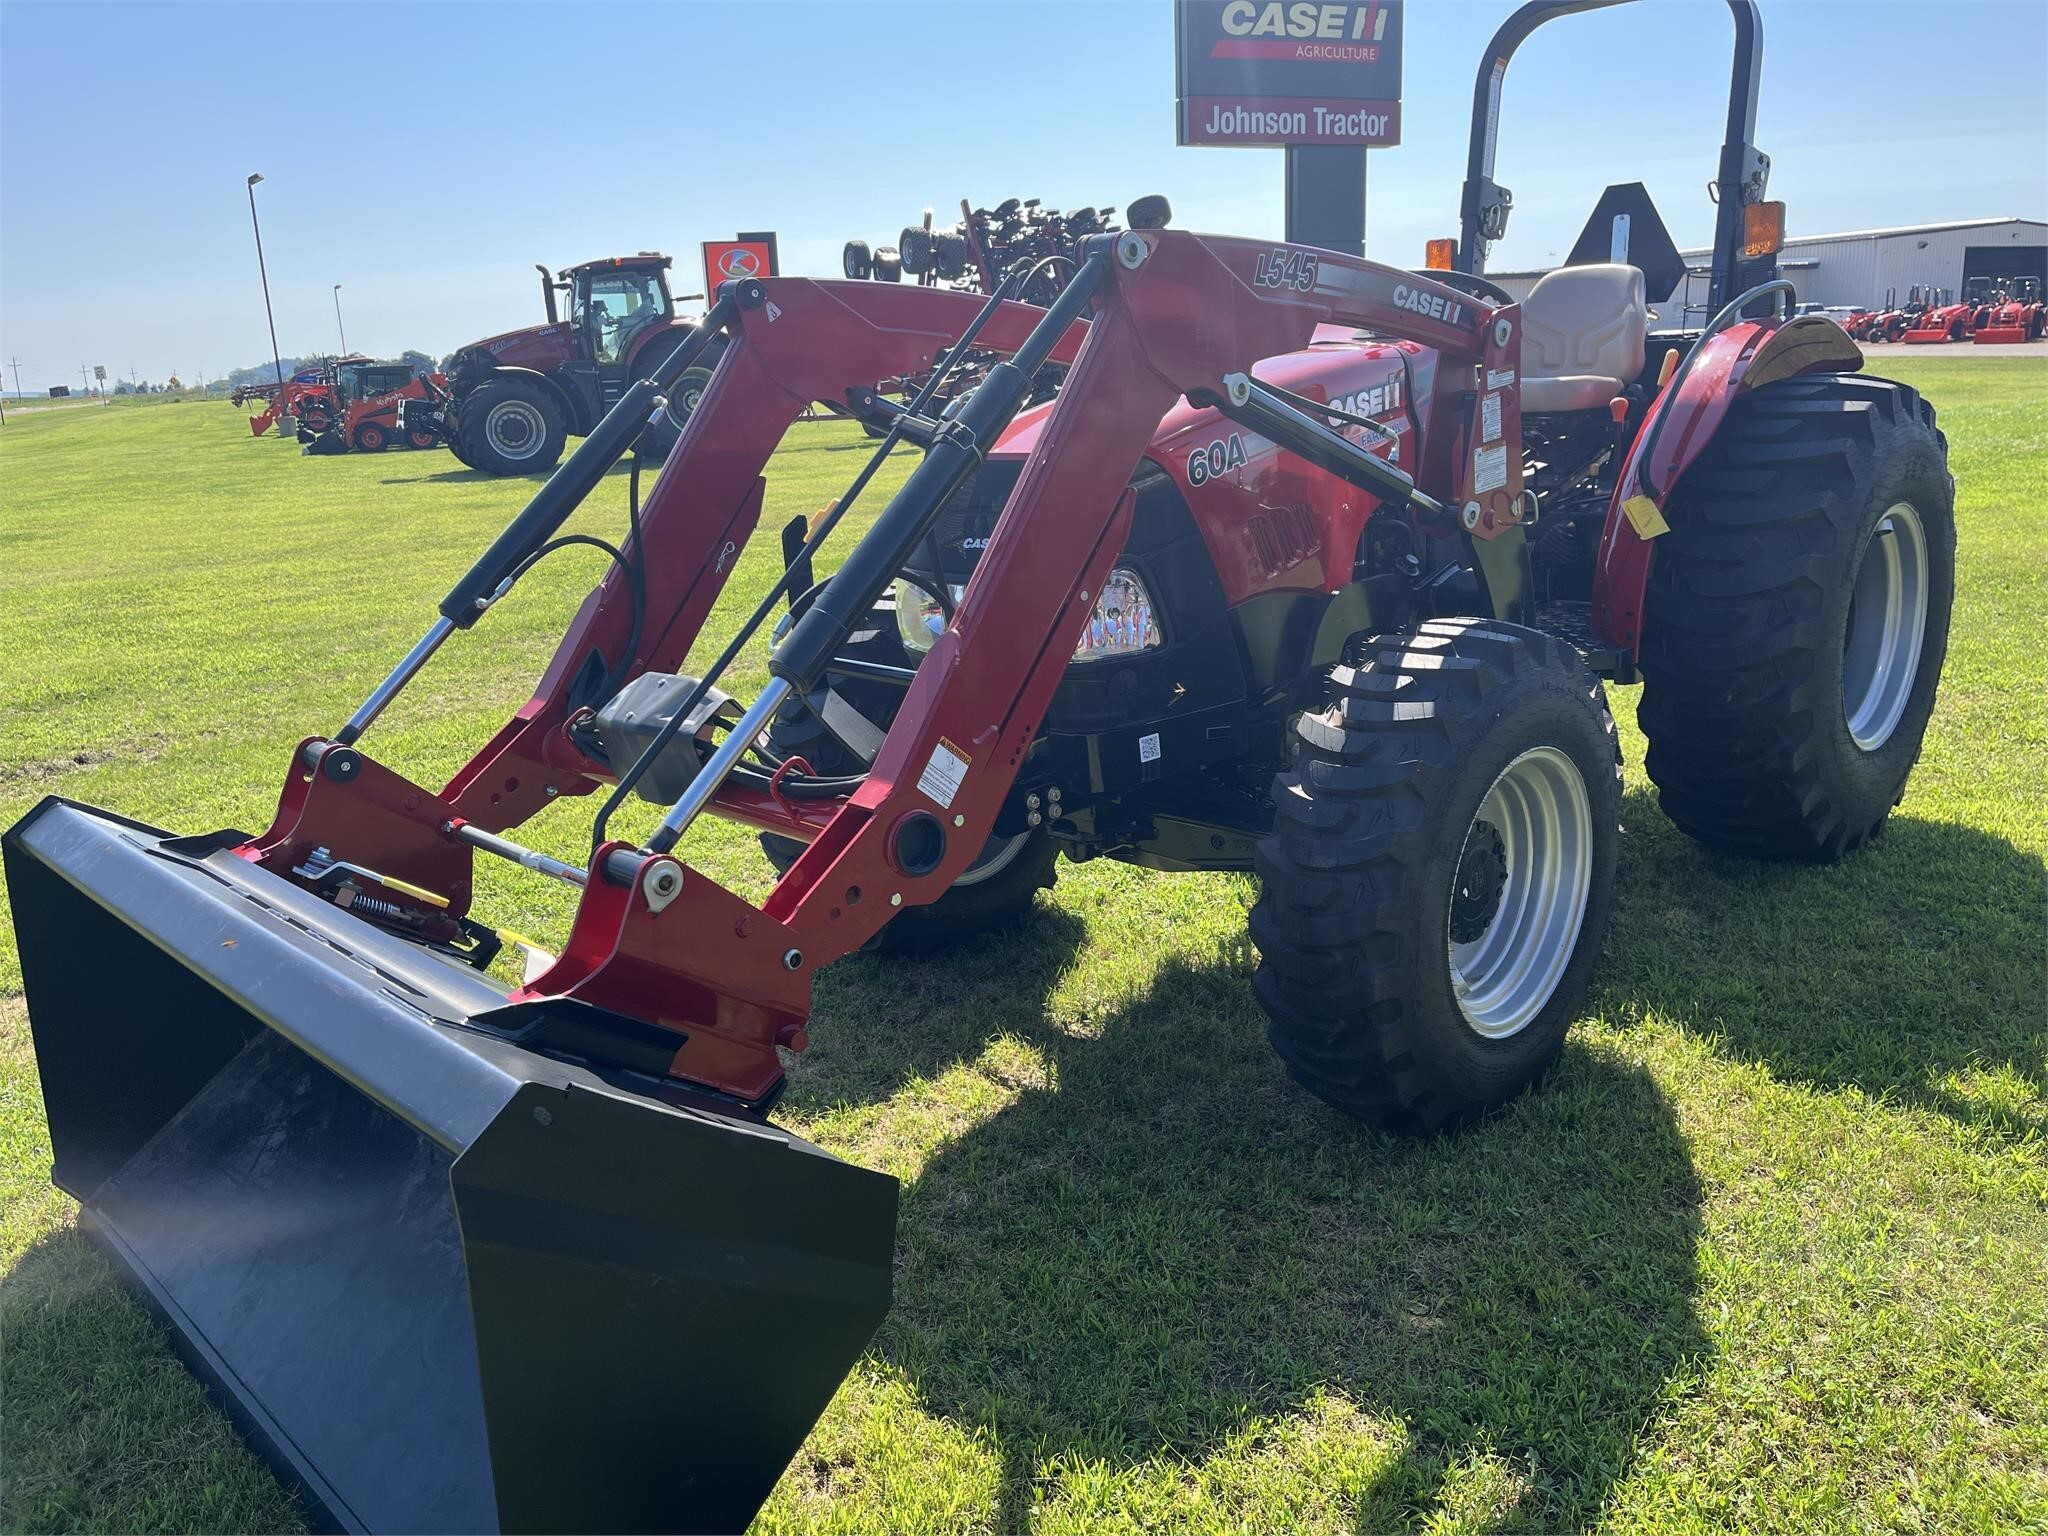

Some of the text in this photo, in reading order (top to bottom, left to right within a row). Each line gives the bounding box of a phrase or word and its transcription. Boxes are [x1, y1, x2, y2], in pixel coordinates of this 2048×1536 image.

[1221, 2, 1347, 39] CASE
[1295, 44, 1376, 61] AGRICULTURE
[1205, 104, 1389, 137] Johnson Tractor
[1254, 248, 1318, 292] L545
[1393, 284, 1444, 319] CASE
[375, 391, 405, 407] Kubota
[1327, 387, 1383, 427] CASE
[1187, 432, 1248, 488] 60A
[963, 537, 991, 549] CAS
[945, 740, 971, 764] WARNING
